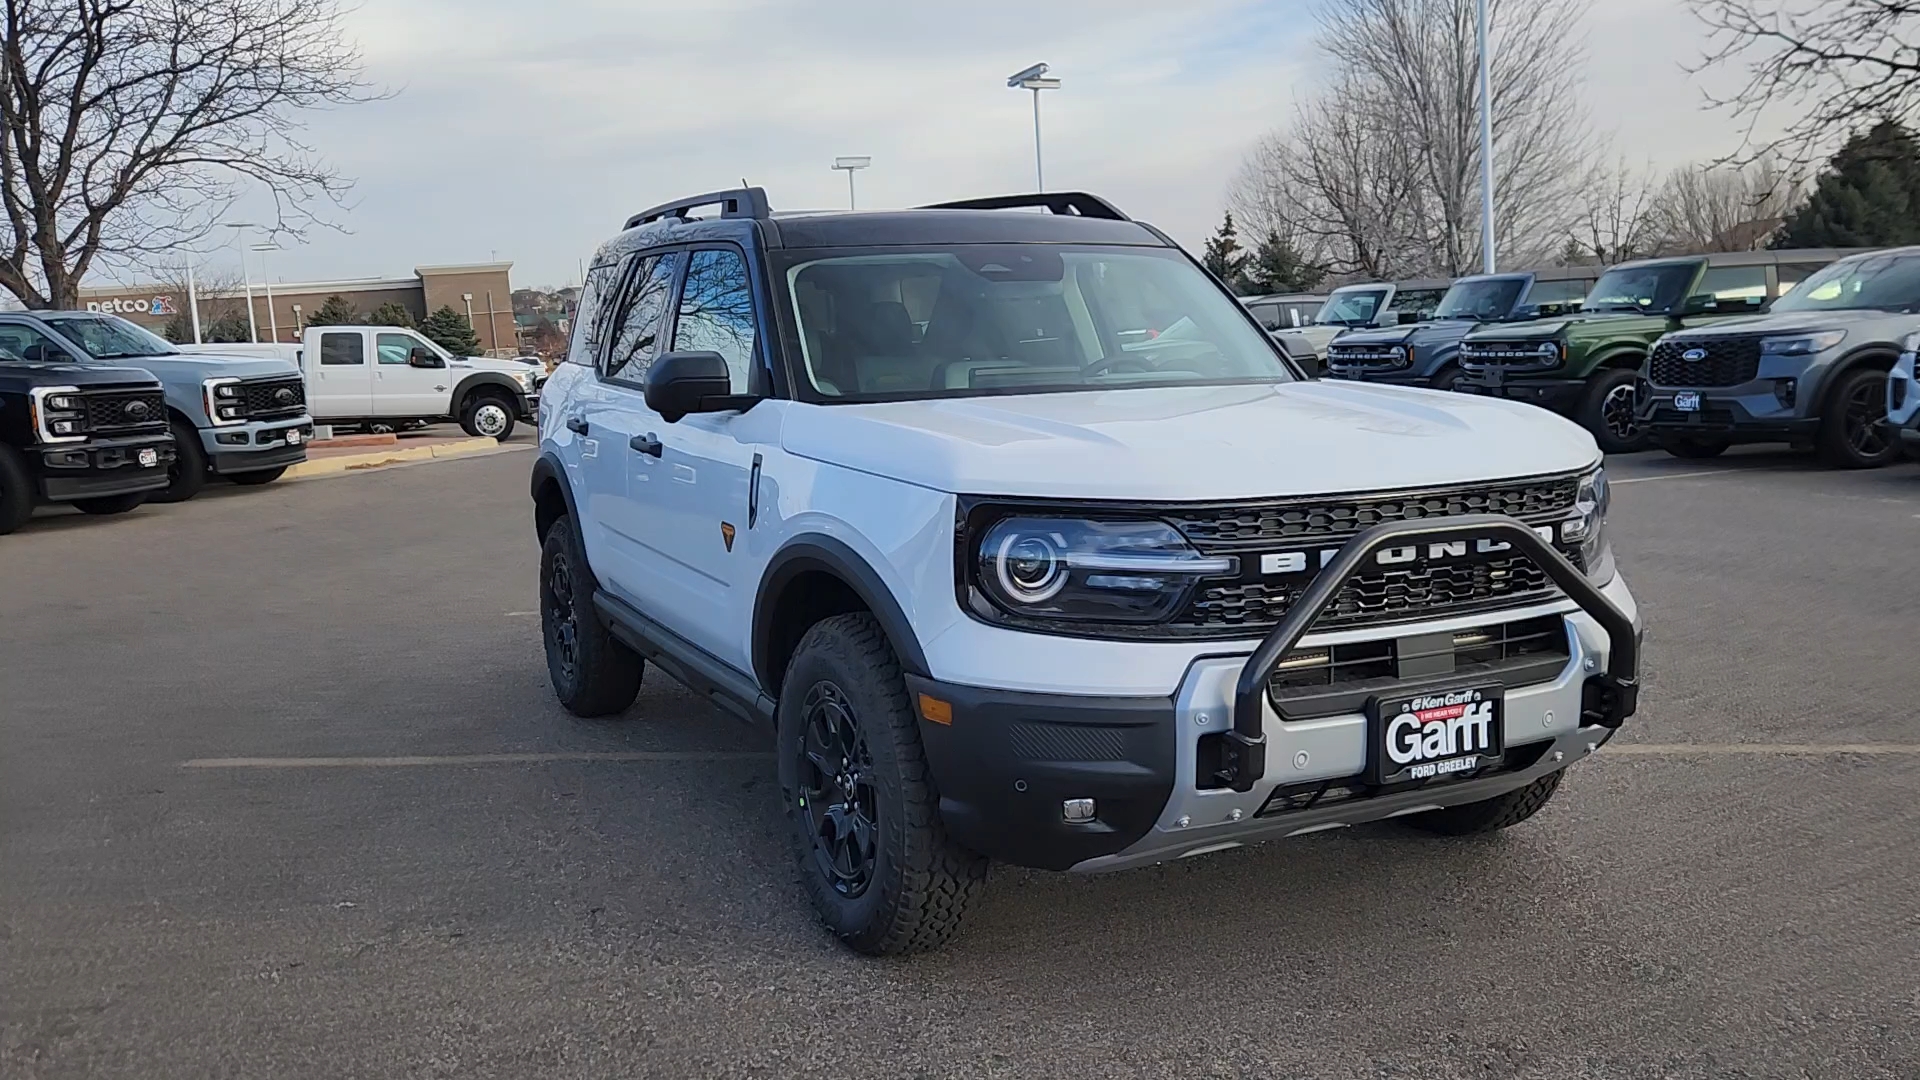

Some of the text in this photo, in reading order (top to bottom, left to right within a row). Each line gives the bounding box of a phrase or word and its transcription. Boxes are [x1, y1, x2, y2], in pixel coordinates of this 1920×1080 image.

[86, 297, 148, 313] petco
[1675, 394, 1700, 408] Garff
[1422, 697, 1444, 710] Ken
[1445, 690, 1474, 706] Garff
[1386, 701, 1492, 764] Garff
[1411, 757, 1477, 779] FORD GREELEY
